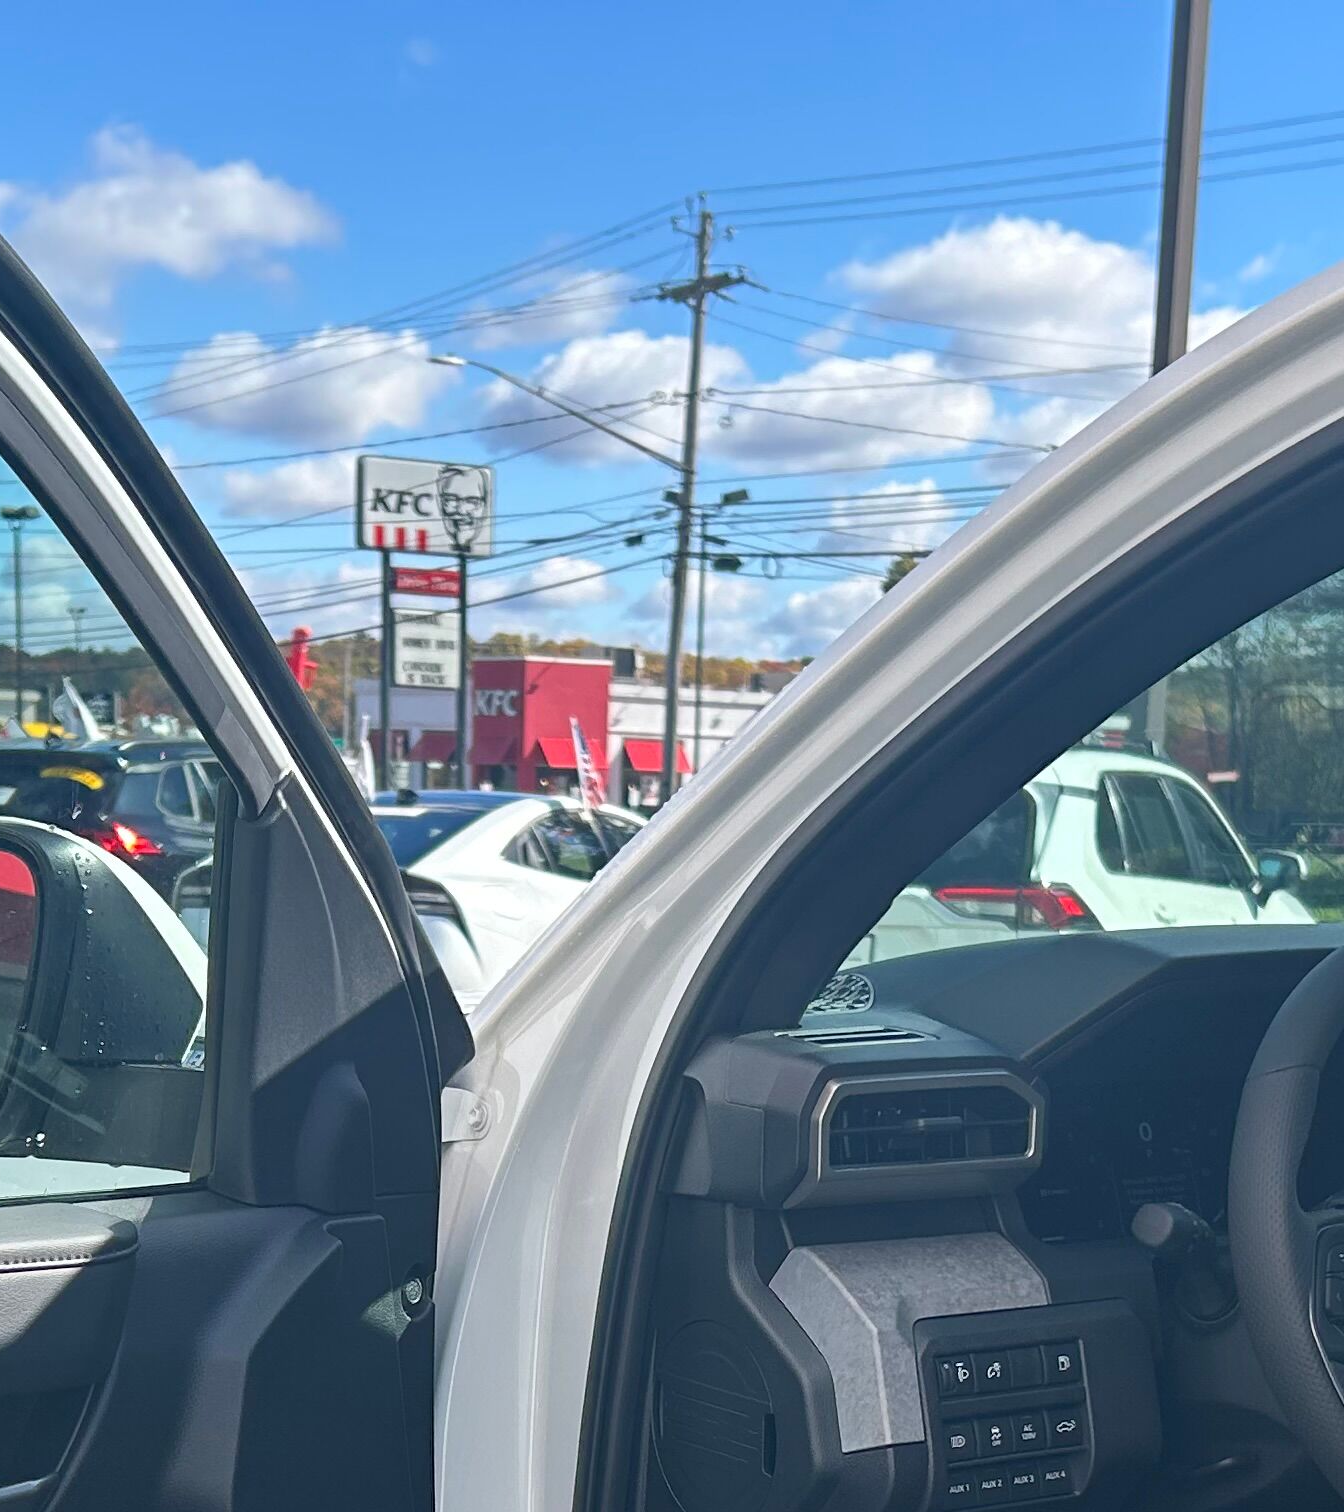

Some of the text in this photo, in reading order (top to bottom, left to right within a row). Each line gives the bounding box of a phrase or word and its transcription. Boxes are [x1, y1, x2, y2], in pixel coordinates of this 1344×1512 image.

[370, 488, 433, 517] KFC
[472, 689, 519, 717] KFC
[1045, 1471, 1060, 1480] AUX
[981, 1480, 996, 1489] AUX
[1013, 1476, 1028, 1485] AUX
[949, 1485, 964, 1494] AUX
